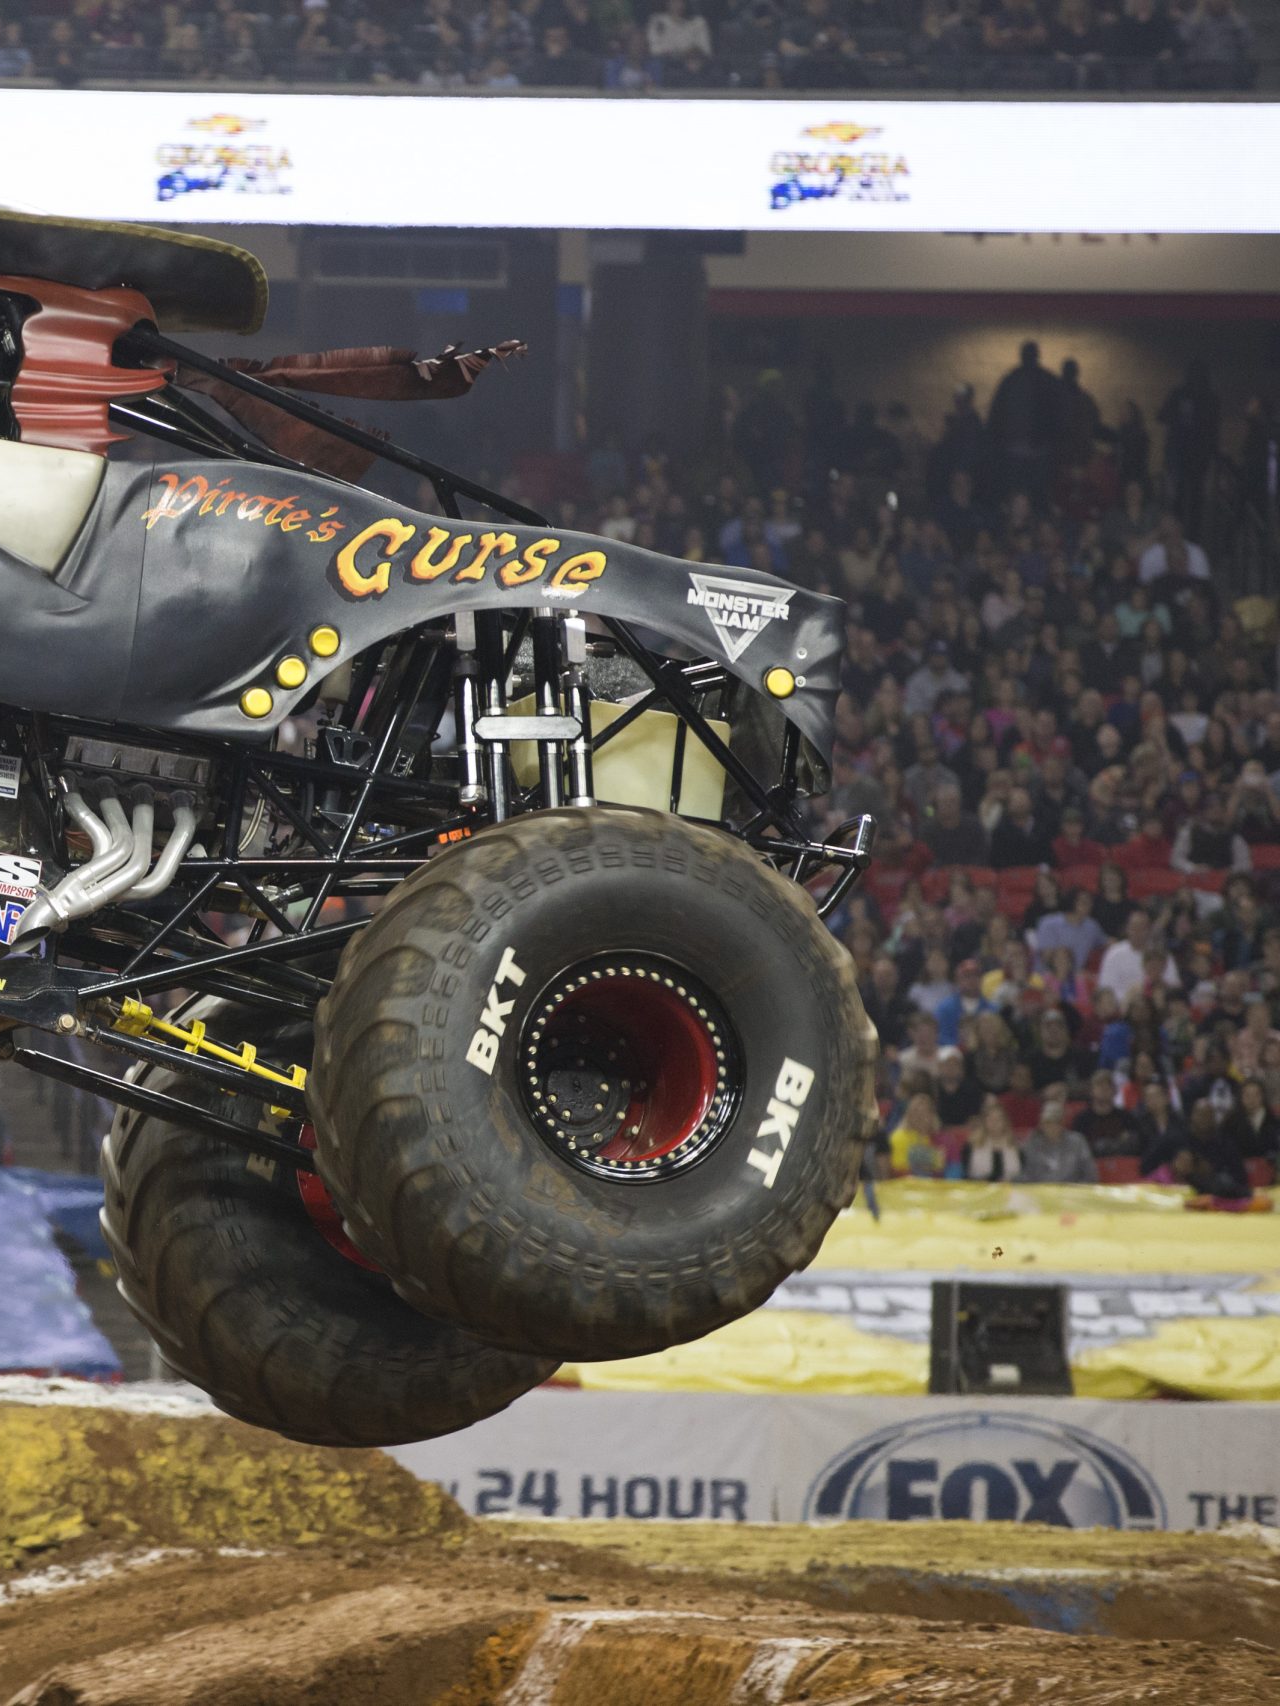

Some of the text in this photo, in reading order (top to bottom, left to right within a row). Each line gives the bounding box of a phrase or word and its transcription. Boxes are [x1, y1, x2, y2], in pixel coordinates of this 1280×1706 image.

[141, 473, 346, 543] Pirate's
[330, 516, 608, 600] Curse
[687, 588, 790, 621] MONSTER
[713, 611, 762, 631] JAM
[9, 765, 17, 773] BY
[465, 946, 528, 1075] BKT
[746, 1057, 815, 1189] BKT
[475, 1468, 748, 1522] 24 HOUR
[886, 1458, 1081, 1528] FOX
[1189, 1490, 1279, 1527] THE
